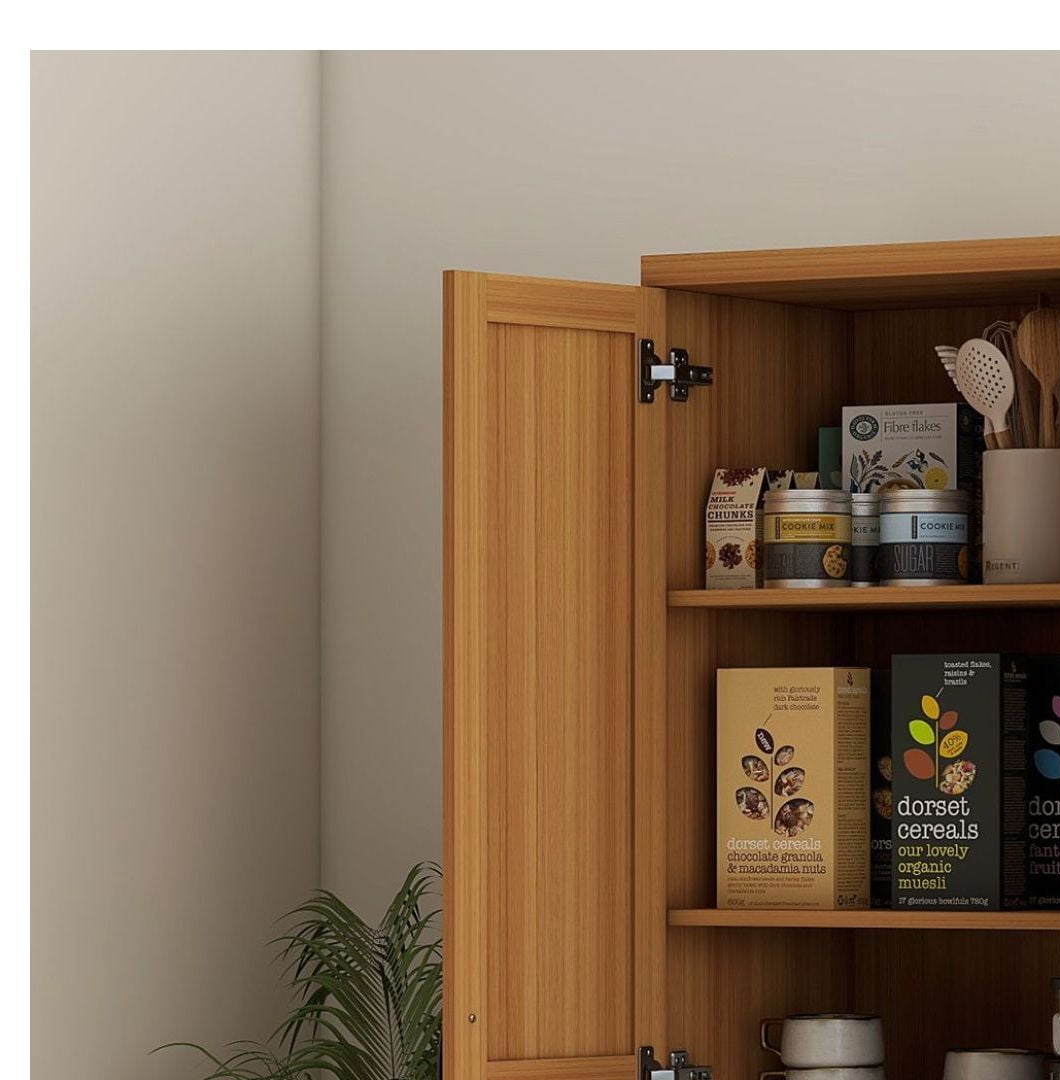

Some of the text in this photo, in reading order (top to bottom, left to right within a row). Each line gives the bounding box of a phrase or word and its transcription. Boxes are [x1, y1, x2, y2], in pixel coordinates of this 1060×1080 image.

[884, 420, 910, 433] Fibre
[912, 419, 942, 432] flakes
[708, 510, 754, 519] CHUNKS
[782, 522, 816, 530] COOKIE
[853, 526, 881, 534] KIE MI
[920, 522, 953, 531] COOKIE
[894, 544, 934, 572] SUGAR
[970, 661, 992, 669] flakes,
[789, 686, 821, 694] gloriously
[756, 731, 772, 752] new
[943, 735, 962, 749] 40%
[897, 795, 970, 816] dorset
[897, 819, 979, 840] cereals
[727, 837, 821, 850] dorset cereals
[871, 839, 892, 850] ors
[727, 851, 824, 863] chocolate granola
[898, 845, 924, 857] our
[926, 843, 970, 860] lovely
[727, 863, 827, 874] & macadamia nuts
[898, 860, 952, 876] organic
[898, 876, 947, 890] muesli
[907, 896, 938, 906] glorious
[938, 896, 969, 905] bowlfuls
